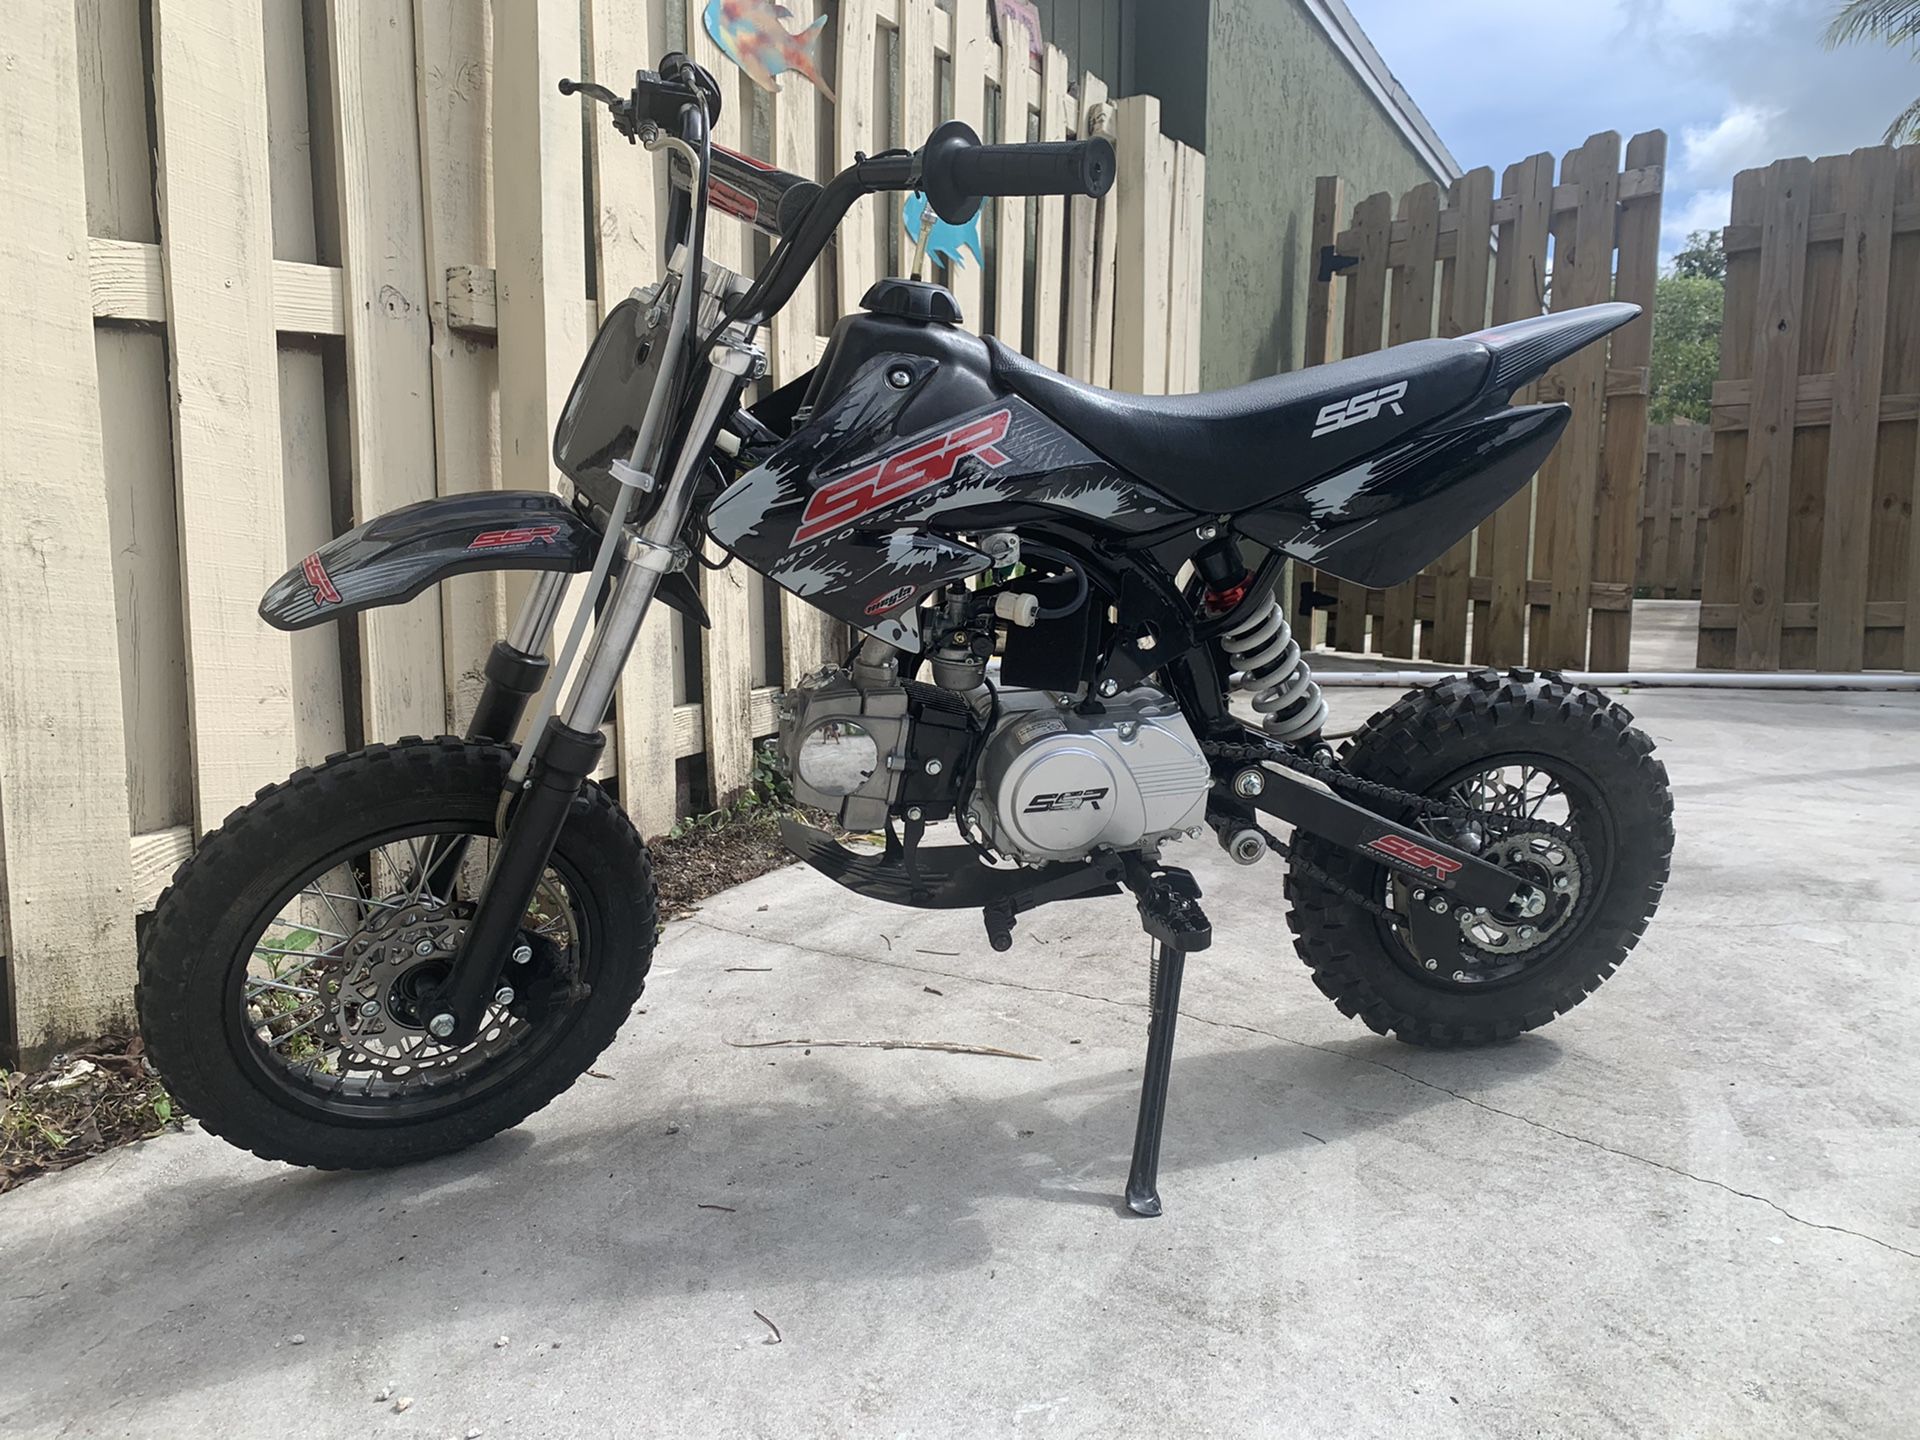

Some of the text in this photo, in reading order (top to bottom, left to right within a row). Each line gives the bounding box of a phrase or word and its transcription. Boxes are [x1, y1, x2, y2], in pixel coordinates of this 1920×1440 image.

[1311, 380, 1409, 439] SSR
[789, 408, 1012, 549] SSR
[467, 525, 561, 544] SSR
[1023, 787, 1109, 814] SSR
[1367, 834, 1462, 880] SSR
